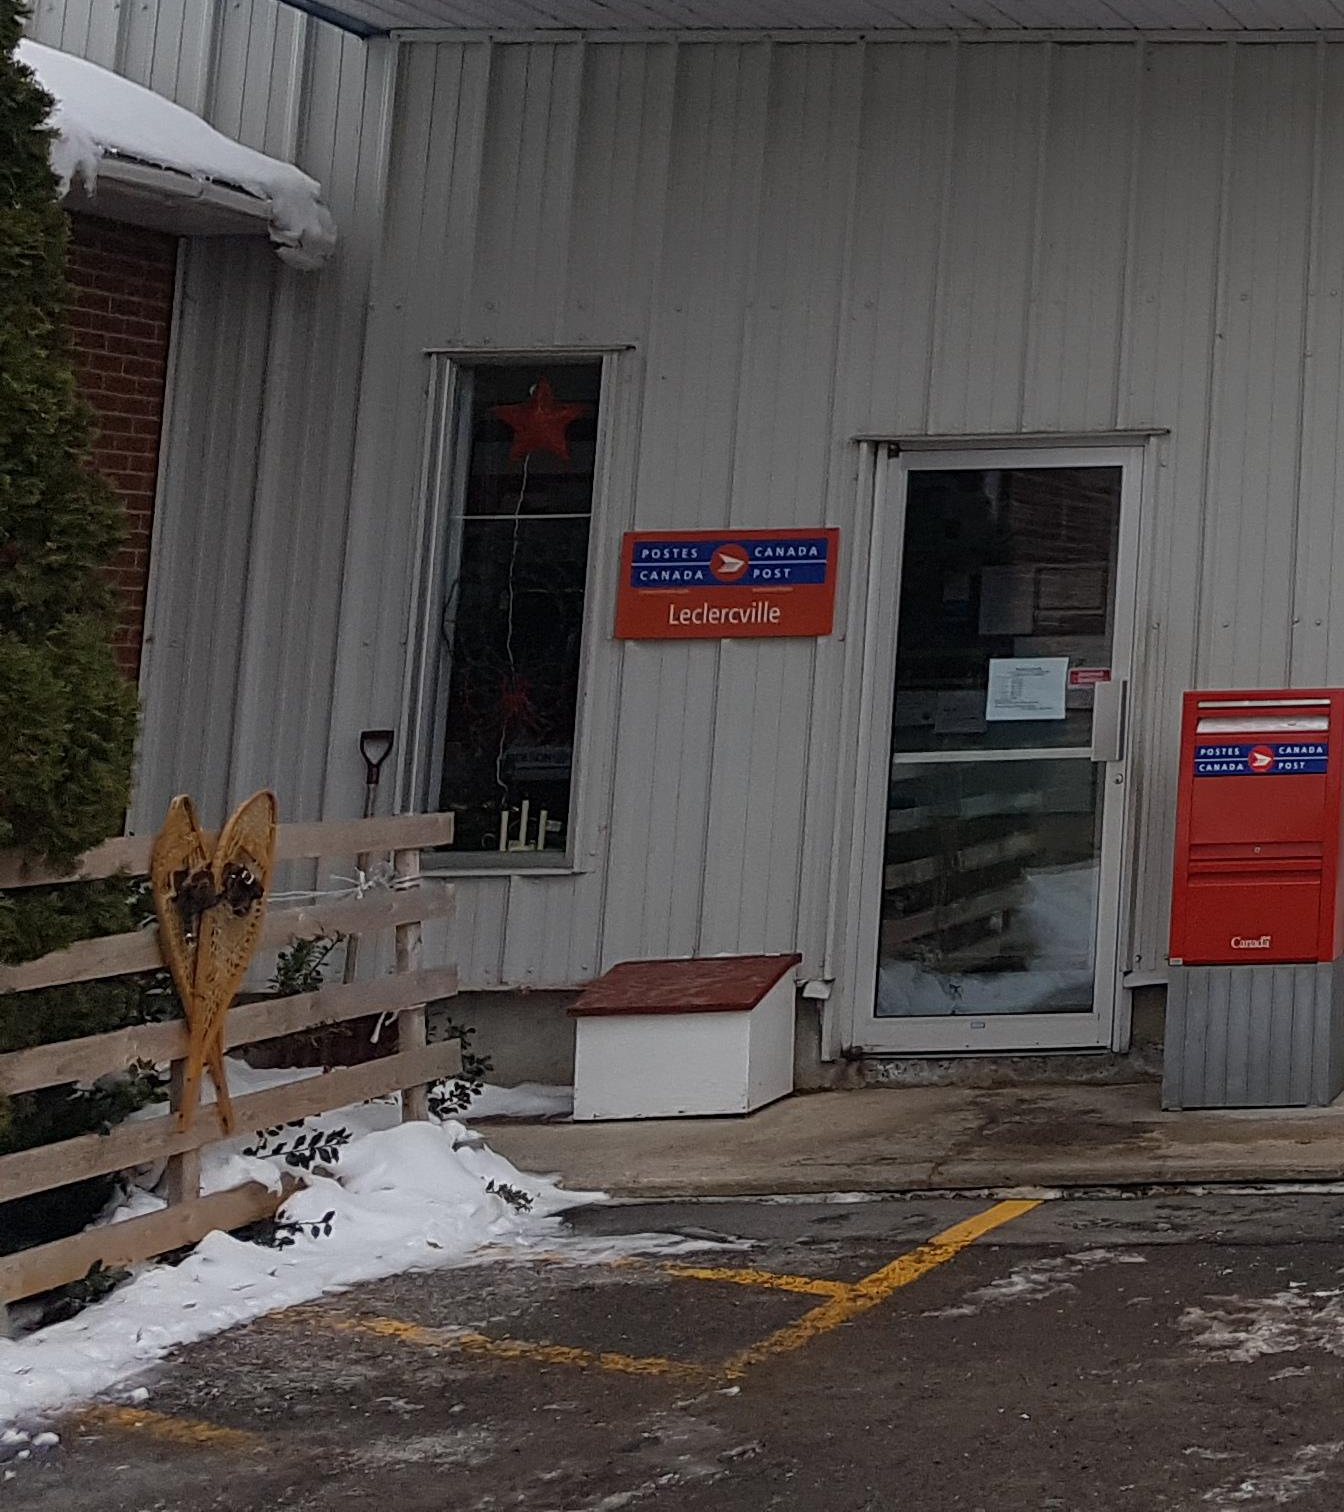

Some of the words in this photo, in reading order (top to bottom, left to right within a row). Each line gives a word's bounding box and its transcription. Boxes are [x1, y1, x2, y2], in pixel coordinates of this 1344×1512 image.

[642, 548, 698, 560] POSTES
[754, 546, 819, 558] CANADA
[639, 569, 704, 581] CANADA
[752, 567, 791, 579] POST
[667, 600, 782, 626] Leclercville
[1199, 746, 1241, 757] POSTES
[1278, 745, 1324, 756] CANADA
[1198, 762, 1246, 773] CANADA
[1277, 760, 1306, 771] POST
